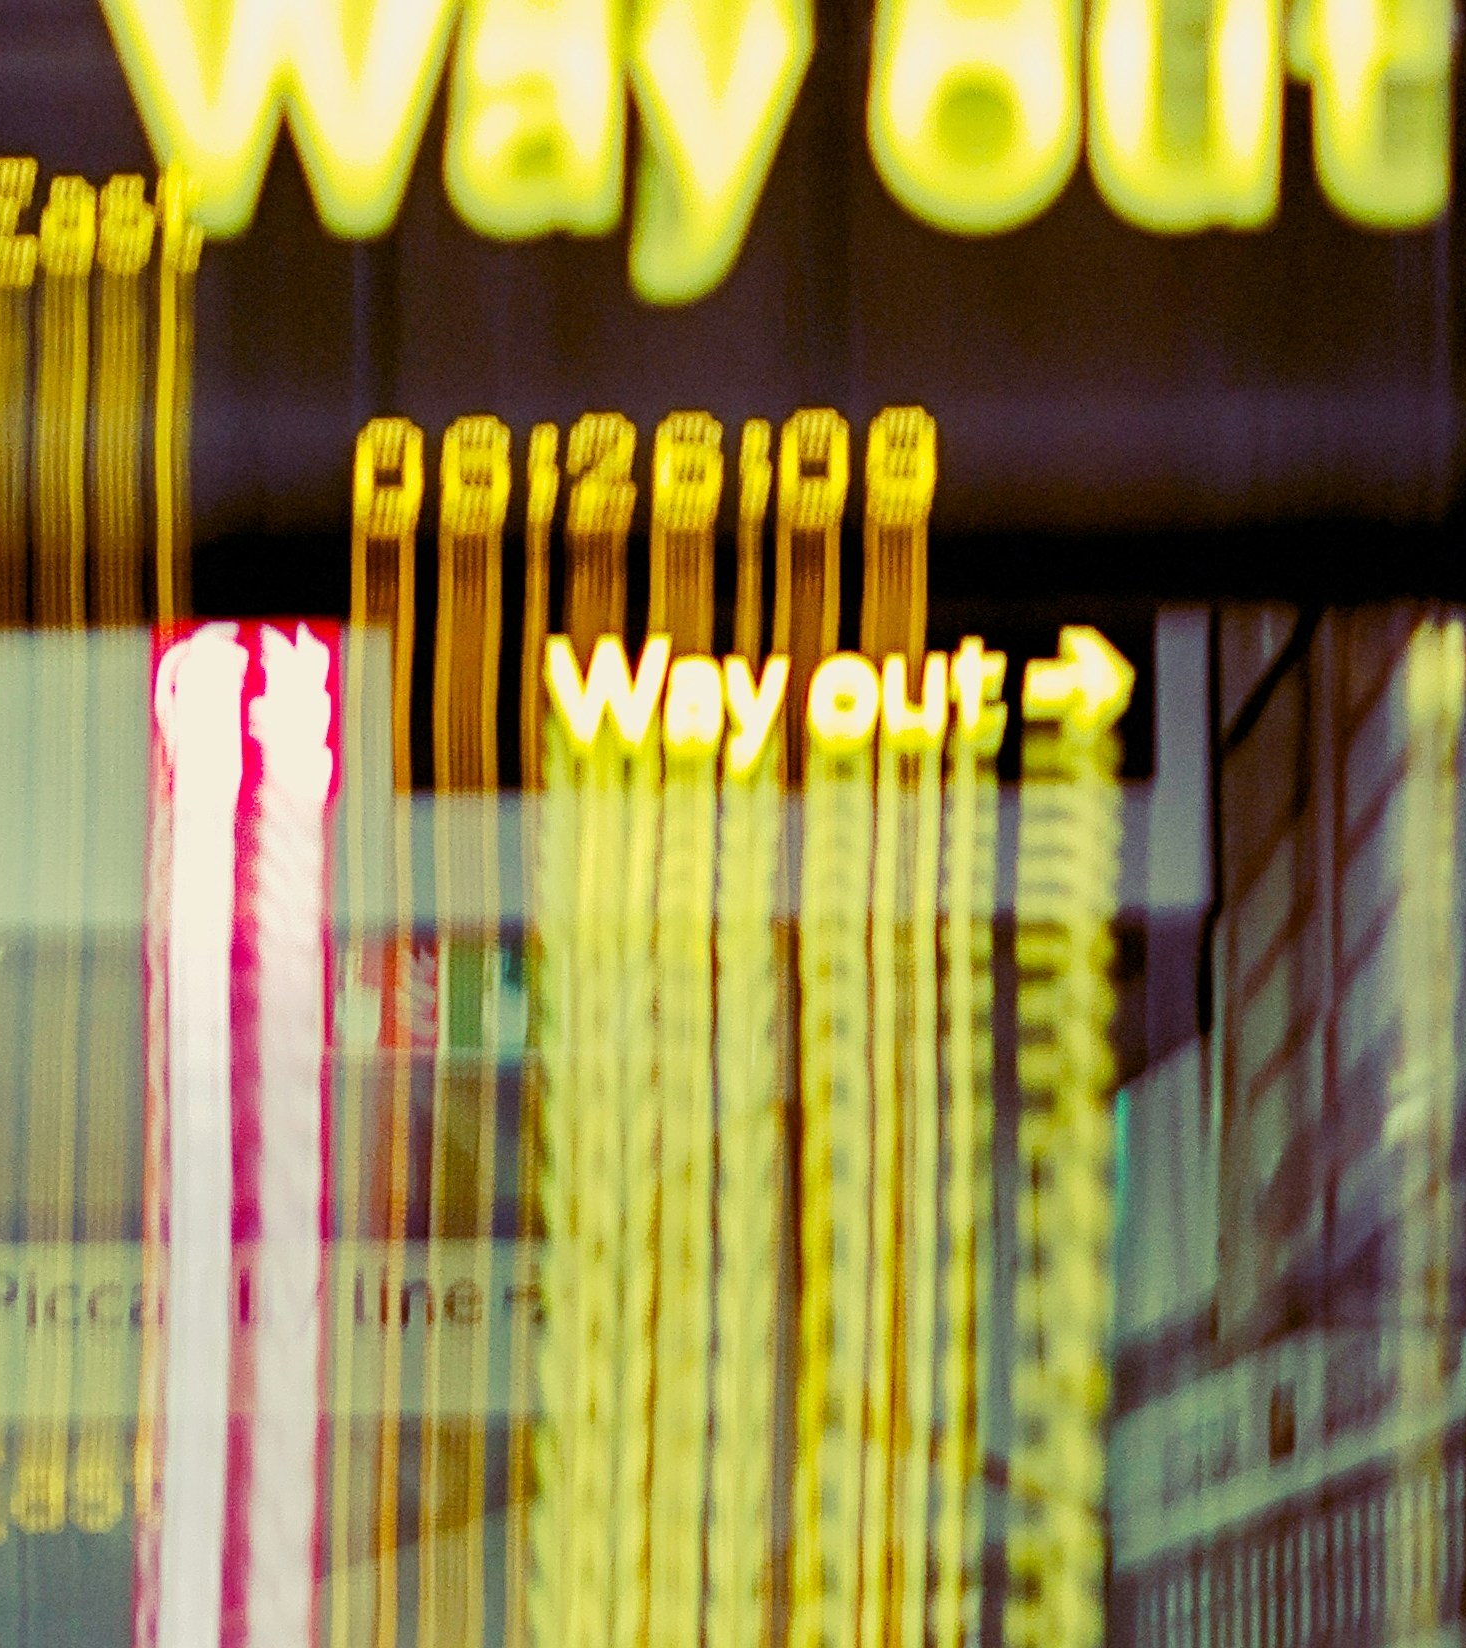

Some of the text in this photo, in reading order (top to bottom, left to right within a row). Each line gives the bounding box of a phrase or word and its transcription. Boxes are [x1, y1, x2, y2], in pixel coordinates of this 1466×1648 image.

[103, 0, 1452, 304] Way out
[545, 632, 1007, 775] Way out
[350, 1264, 481, 1332] line
